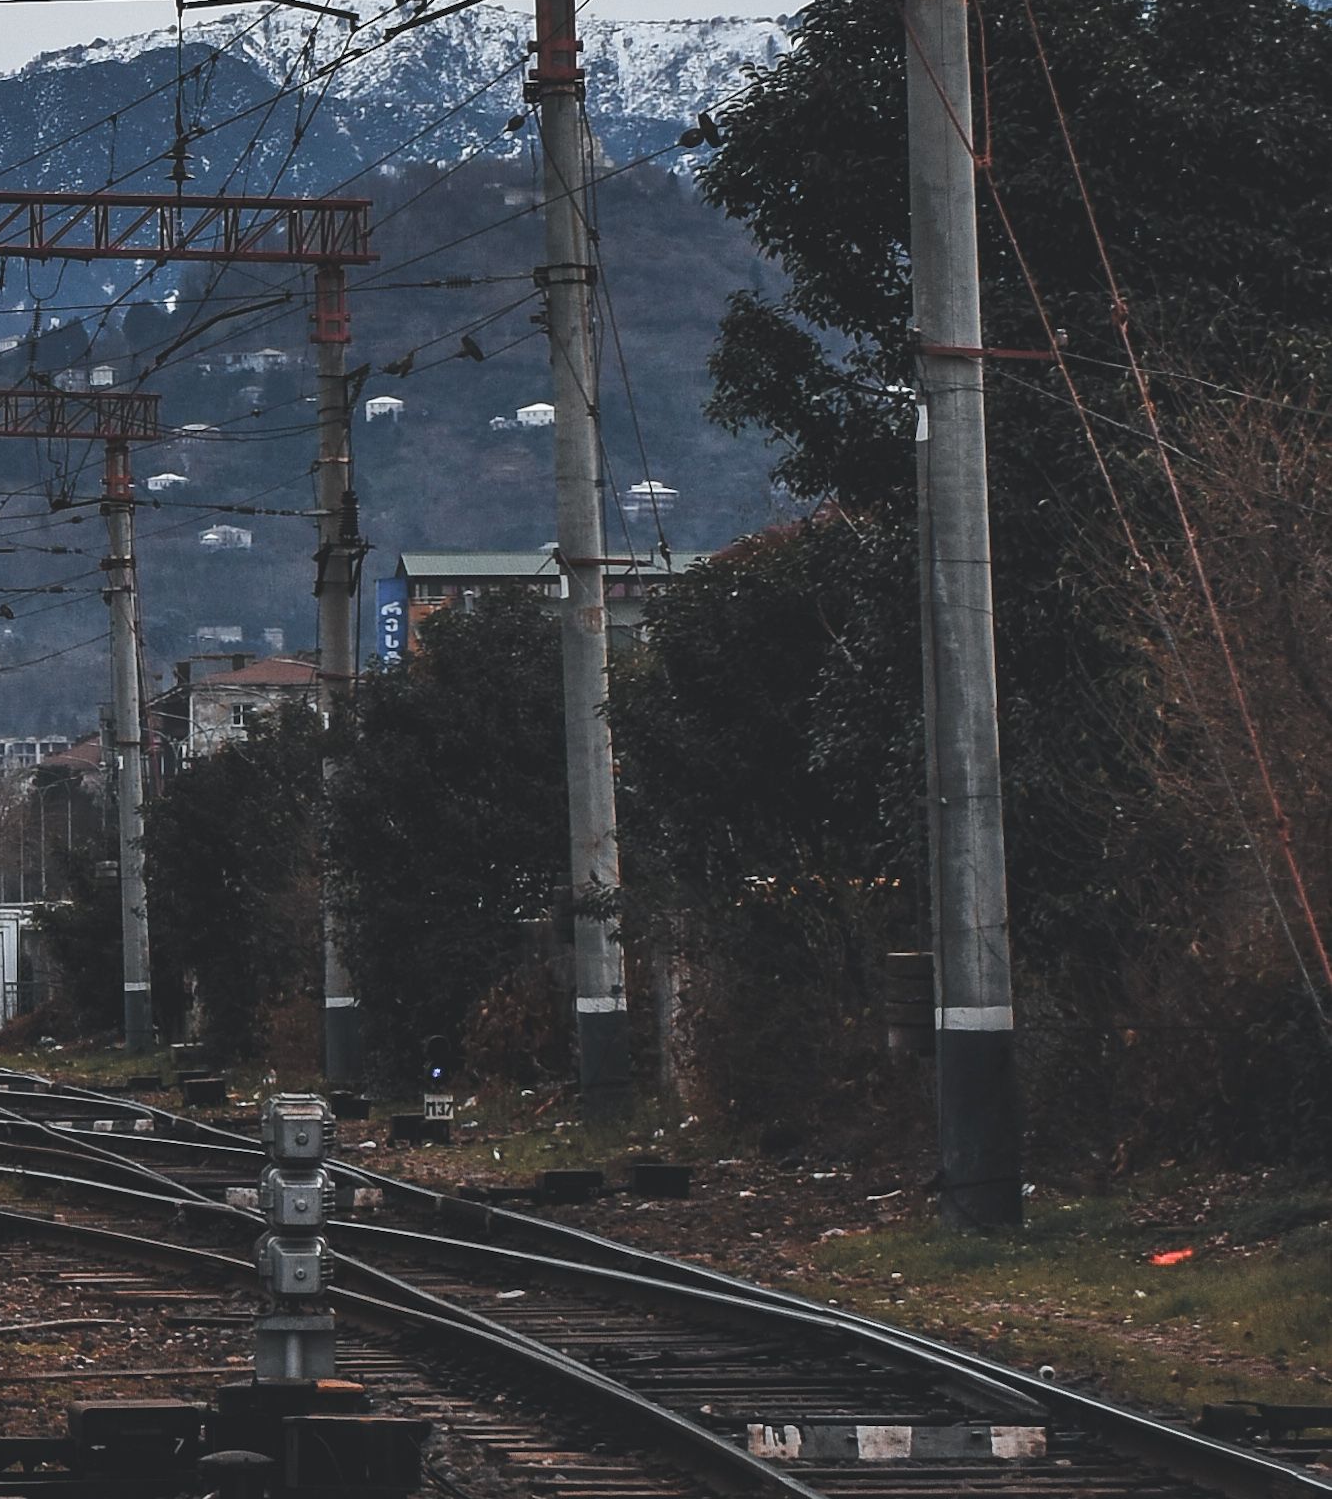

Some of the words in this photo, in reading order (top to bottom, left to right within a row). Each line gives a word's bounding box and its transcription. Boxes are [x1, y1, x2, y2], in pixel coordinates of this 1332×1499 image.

[381, 601, 403, 674] რესტ
[426, 1101, 454, 1117] M37
[174, 1437, 185, 1454] 7
